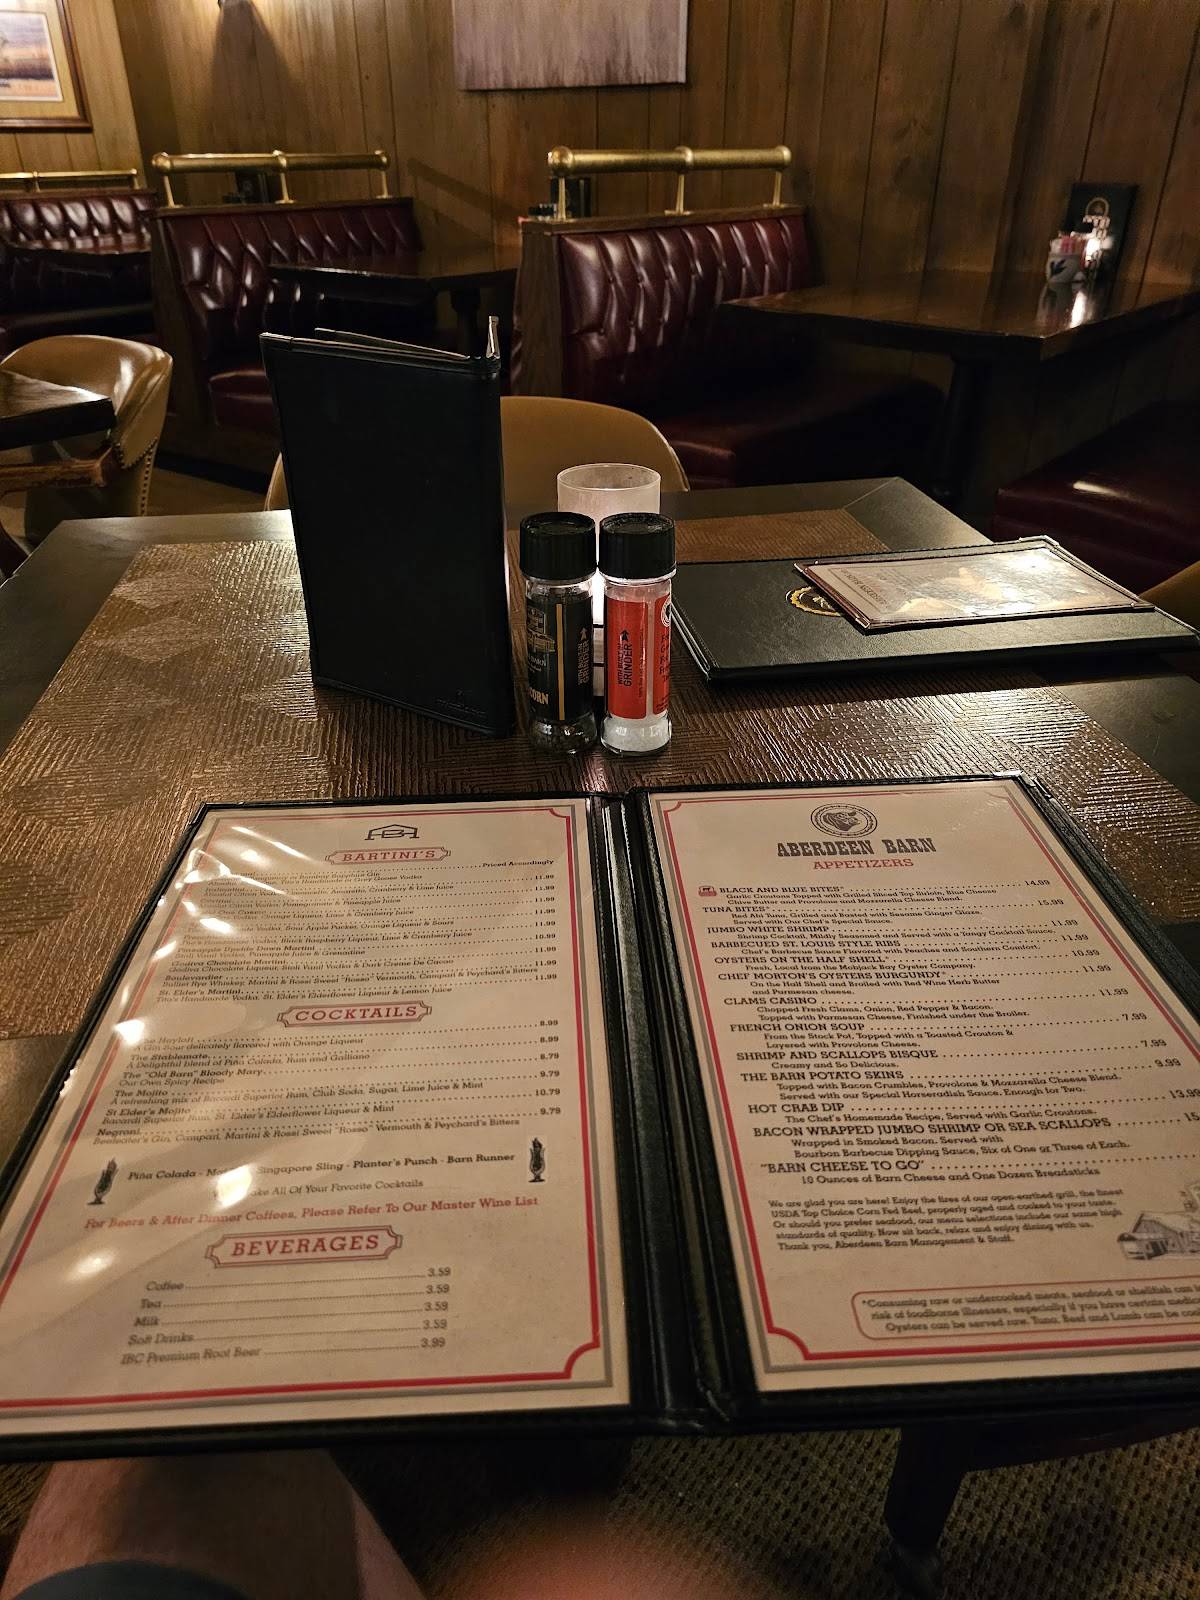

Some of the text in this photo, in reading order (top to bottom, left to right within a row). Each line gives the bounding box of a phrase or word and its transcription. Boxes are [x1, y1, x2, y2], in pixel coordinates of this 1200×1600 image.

[624, 644, 632, 686] GRINDER
[529, 686, 549, 704] CORN
[342, 849, 435, 862] BARTINI'S
[777, 837, 936, 857] ABERDEEN BARN
[813, 858, 914, 869] APPETIZERS
[1071, 948, 1100, 956] 10.99
[1082, 964, 1111, 972] 11.99
[1099, 988, 1128, 996] 11.99
[295, 1006, 417, 1021] COCKTAILS
[730, 1012, 1147, 1031] FRENCH ONION SOUP 7.99
[736, 1038, 1167, 1060] SHRIMP AND SCALLOPS BISQUE 7.99
[740, 1057, 1181, 1081] THE BARN POTATO SKINS 9.99
[535, 1088, 560, 1096] 10.79
[540, 1107, 560, 1115] 9.79
[748, 1104, 777, 1113] HOT
[781, 1103, 818, 1113] CRAB
[821, 1102, 844, 1112] DIP
[784, 1115, 805, 1123] The
[807, 1114, 841, 1122] Chef's
[842, 1112, 903, 1122] Homemade
[945, 1111, 982, 1120] Served
[984, 1111, 1008, 1119] with
[1009, 1110, 1042, 1118] Garlic
[753, 1117, 1111, 1137] BACON WRAPPED JUMBO SHRIMP OR SEA SCALLOPS
[791, 1137, 841, 1149] Wrapped
[855, 1136, 900, 1145] Smoked
[939, 1135, 978, 1144] Served
[979, 1134, 1003, 1142] with
[794, 1148, 840, 1158] Bourbon
[841, 1147, 894, 1157] Barbecue
[895, 1146, 940, 1158] Dipping
[980, 1145, 998, 1154] Six
[1000, 1145, 1012, 1153] of
[1013, 1144, 1036, 1152] One
[1051, 1142, 1084, 1151] Three
[1086, 1141, 1097, 1150] of
[155, 1169, 196, 1179] Colada
[353, 1158, 401, 1168] Planter's
[404, 1156, 437, 1166] Punch
[447, 1154, 473, 1163] Barn
[476, 1152, 514, 1162] Runner
[810, 1160, 868, 1172] CHEESE
[870, 1160, 892, 1170] TO
[816, 1174, 859, 1184] Ounces
[861, 1174, 872, 1182] of
[874, 1173, 902, 1182] Barn
[903, 1172, 946, 1182] Cheese
[948, 1172, 970, 1181] and
[972, 1170, 996, 1180] One
[997, 1169, 1034, 1179] Dozen
[1034, 1166, 1100, 1177] Breadsticks
[305, 1183, 328, 1193] Your
[330, 1180, 372, 1192] Favorite
[374, 1178, 423, 1190] Cocktails
[108, 1215, 144, 1227] Beers
[148, 1215, 158, 1225] &
[162, 1214, 194, 1225] After
[197, 1212, 242, 1224] Dinner
[301, 1205, 344, 1218] Please
[347, 1203, 382, 1215] Refer
[385, 1202, 399, 1213] To
[402, 1201, 427, 1212] Our
[430, 1198, 476, 1211] Master
[479, 1196, 511, 1208] Wine
[515, 1195, 538, 1206] List
[231, 1234, 378, 1256] BEVERAGES
[146, 1266, 451, 1291] Coffee 3.59
[140, 1283, 450, 1309] Tea 3.59
[133, 1300, 448, 1327] Milk 3.59
[154, 1331, 195, 1344] Drinks
[422, 1318, 447, 1330] 3.59
[120, 1336, 446, 1365] IBC Premium Root Beer 3.99
